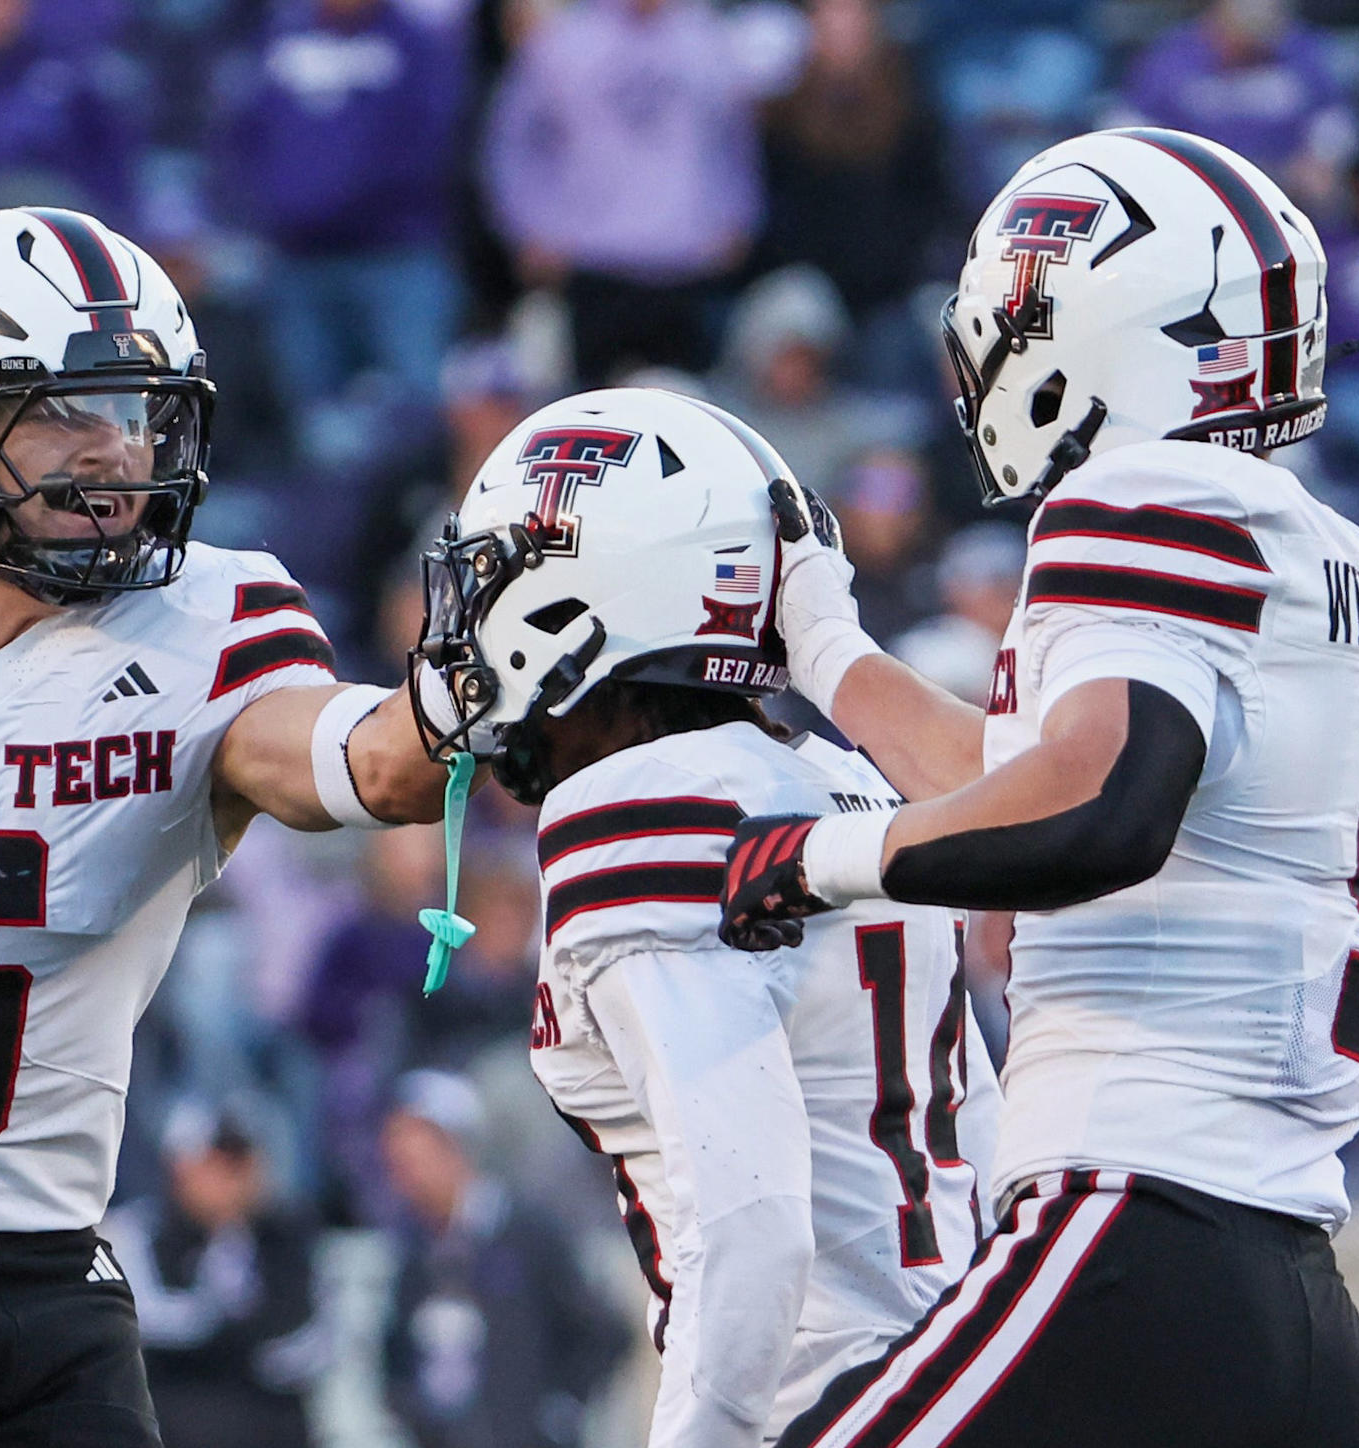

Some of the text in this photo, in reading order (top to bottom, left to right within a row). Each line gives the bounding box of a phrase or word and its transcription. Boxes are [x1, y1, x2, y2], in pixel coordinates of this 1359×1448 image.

[1, 359, 39, 371] GUNS UP
[1208, 402, 1328, 451] RED RAIDERS
[703, 656, 749, 684] RED
[5, 730, 177, 809] TECH
